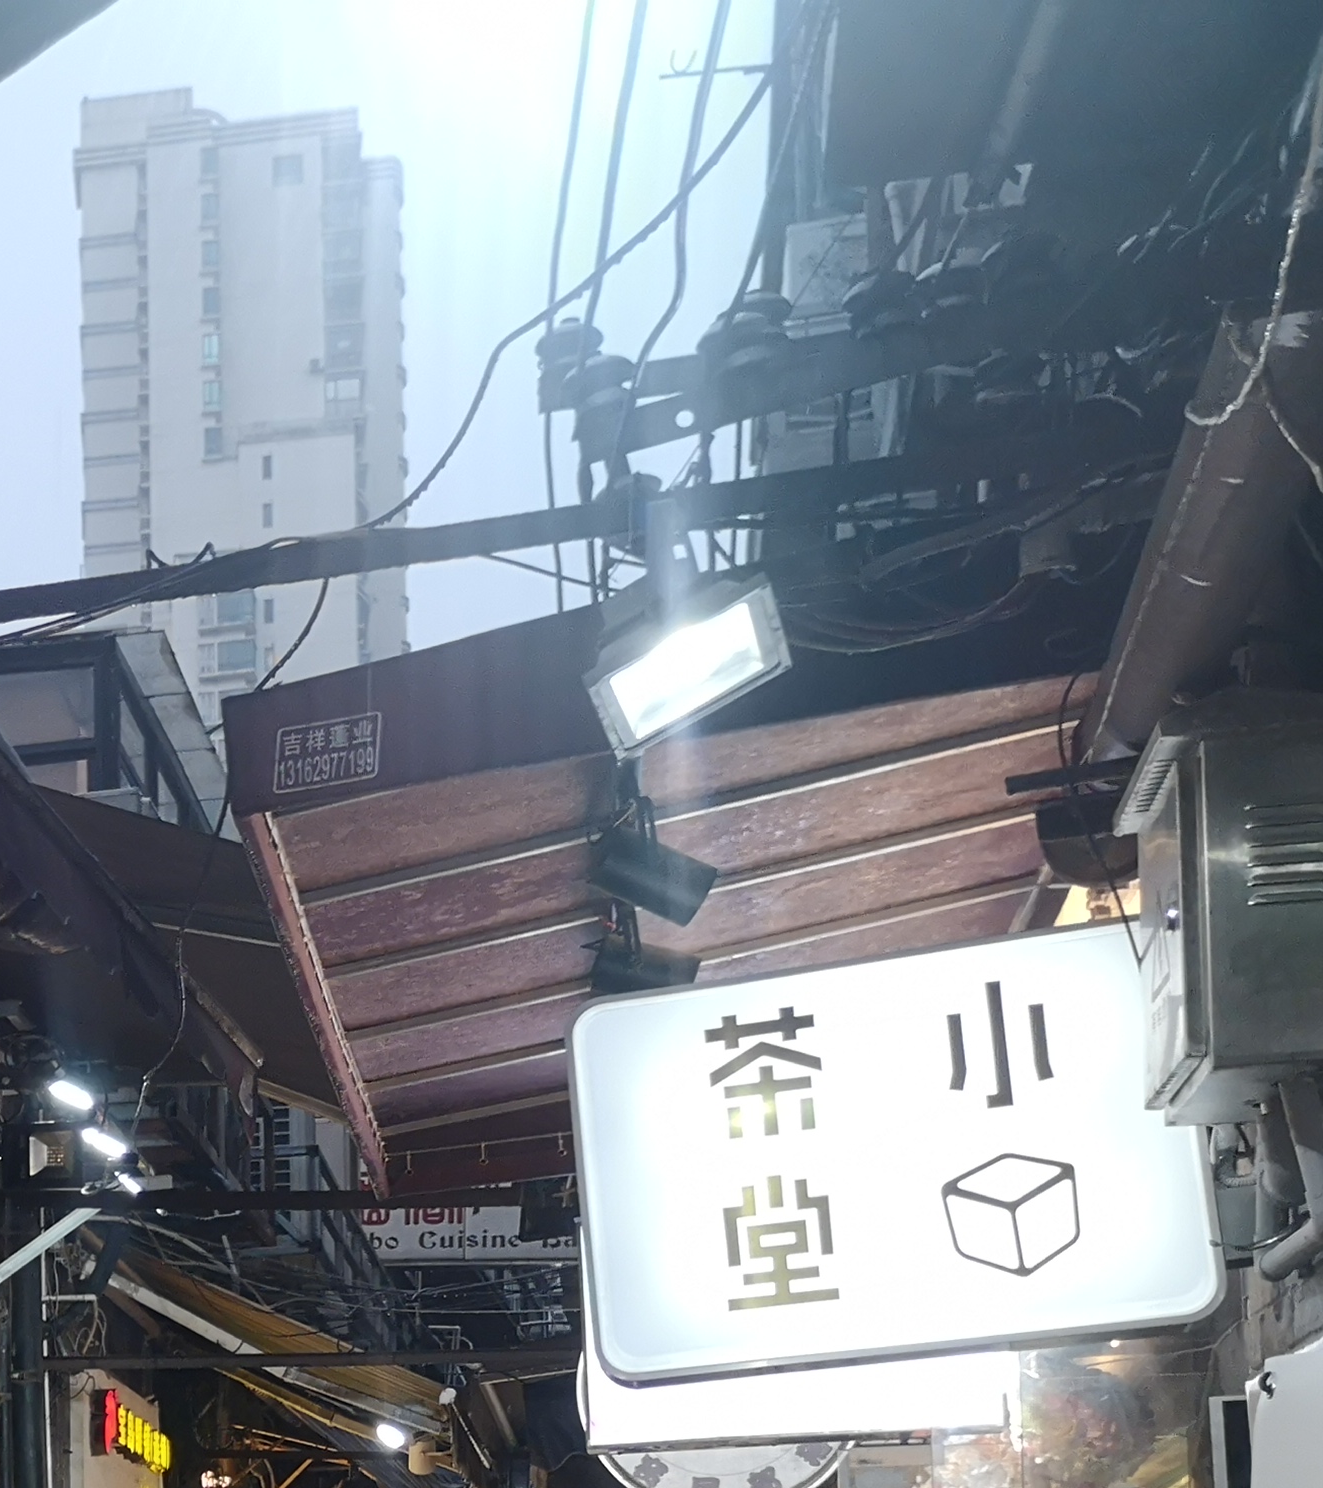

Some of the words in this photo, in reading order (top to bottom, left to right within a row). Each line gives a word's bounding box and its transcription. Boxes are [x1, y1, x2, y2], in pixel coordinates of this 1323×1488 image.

[279, 746, 374, 787] 13162977199
[705, 1007, 839, 1311] 茶堂
[418, 1229, 522, 1250] Cuisine
